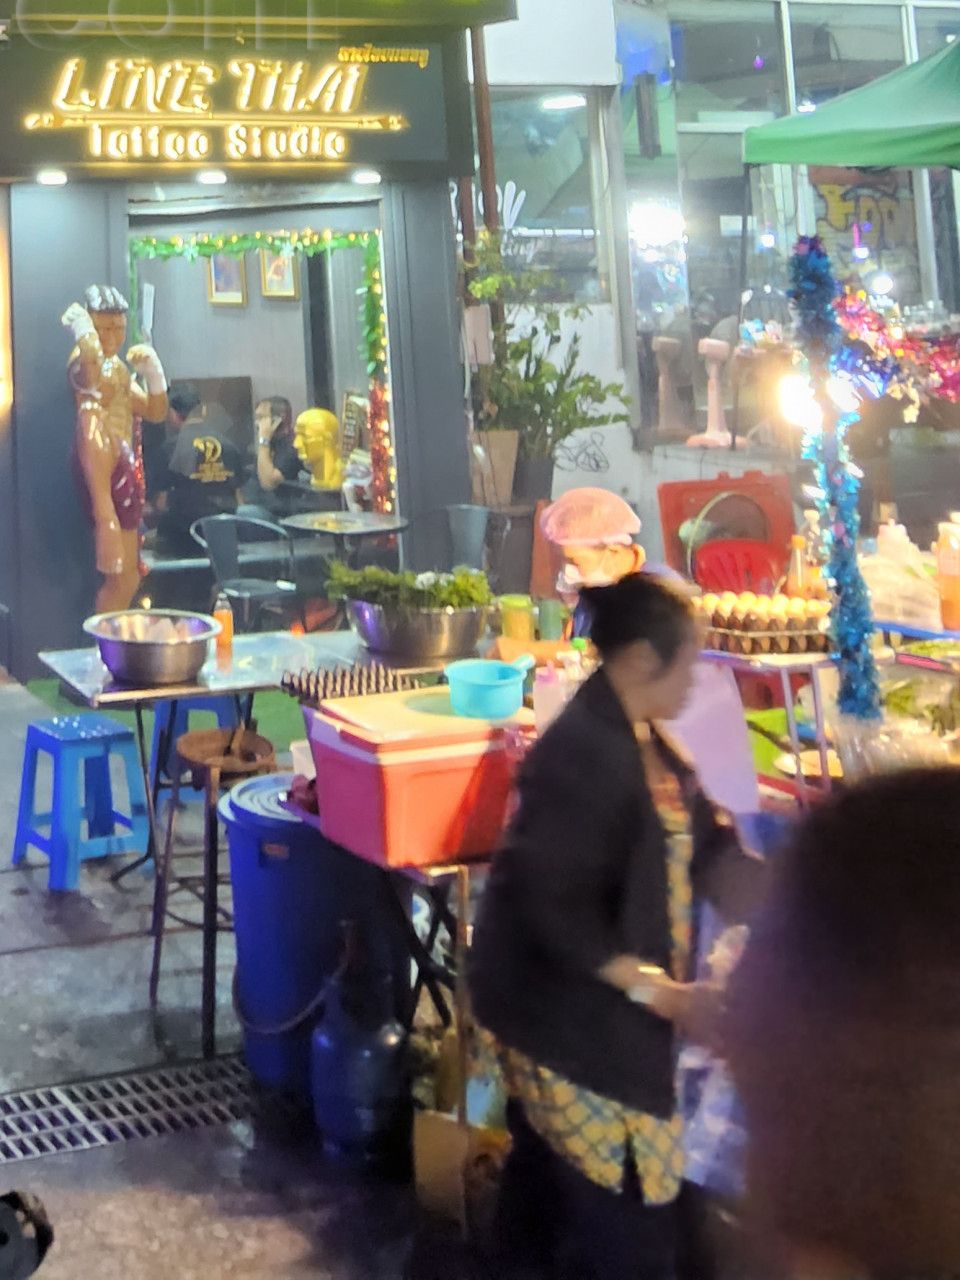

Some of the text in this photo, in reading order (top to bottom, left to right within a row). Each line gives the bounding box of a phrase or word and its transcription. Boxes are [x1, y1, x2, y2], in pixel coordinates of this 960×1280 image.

[53, 56, 368, 114] LINE THAI
[89, 122, 347, 160] Tattoo Studio
